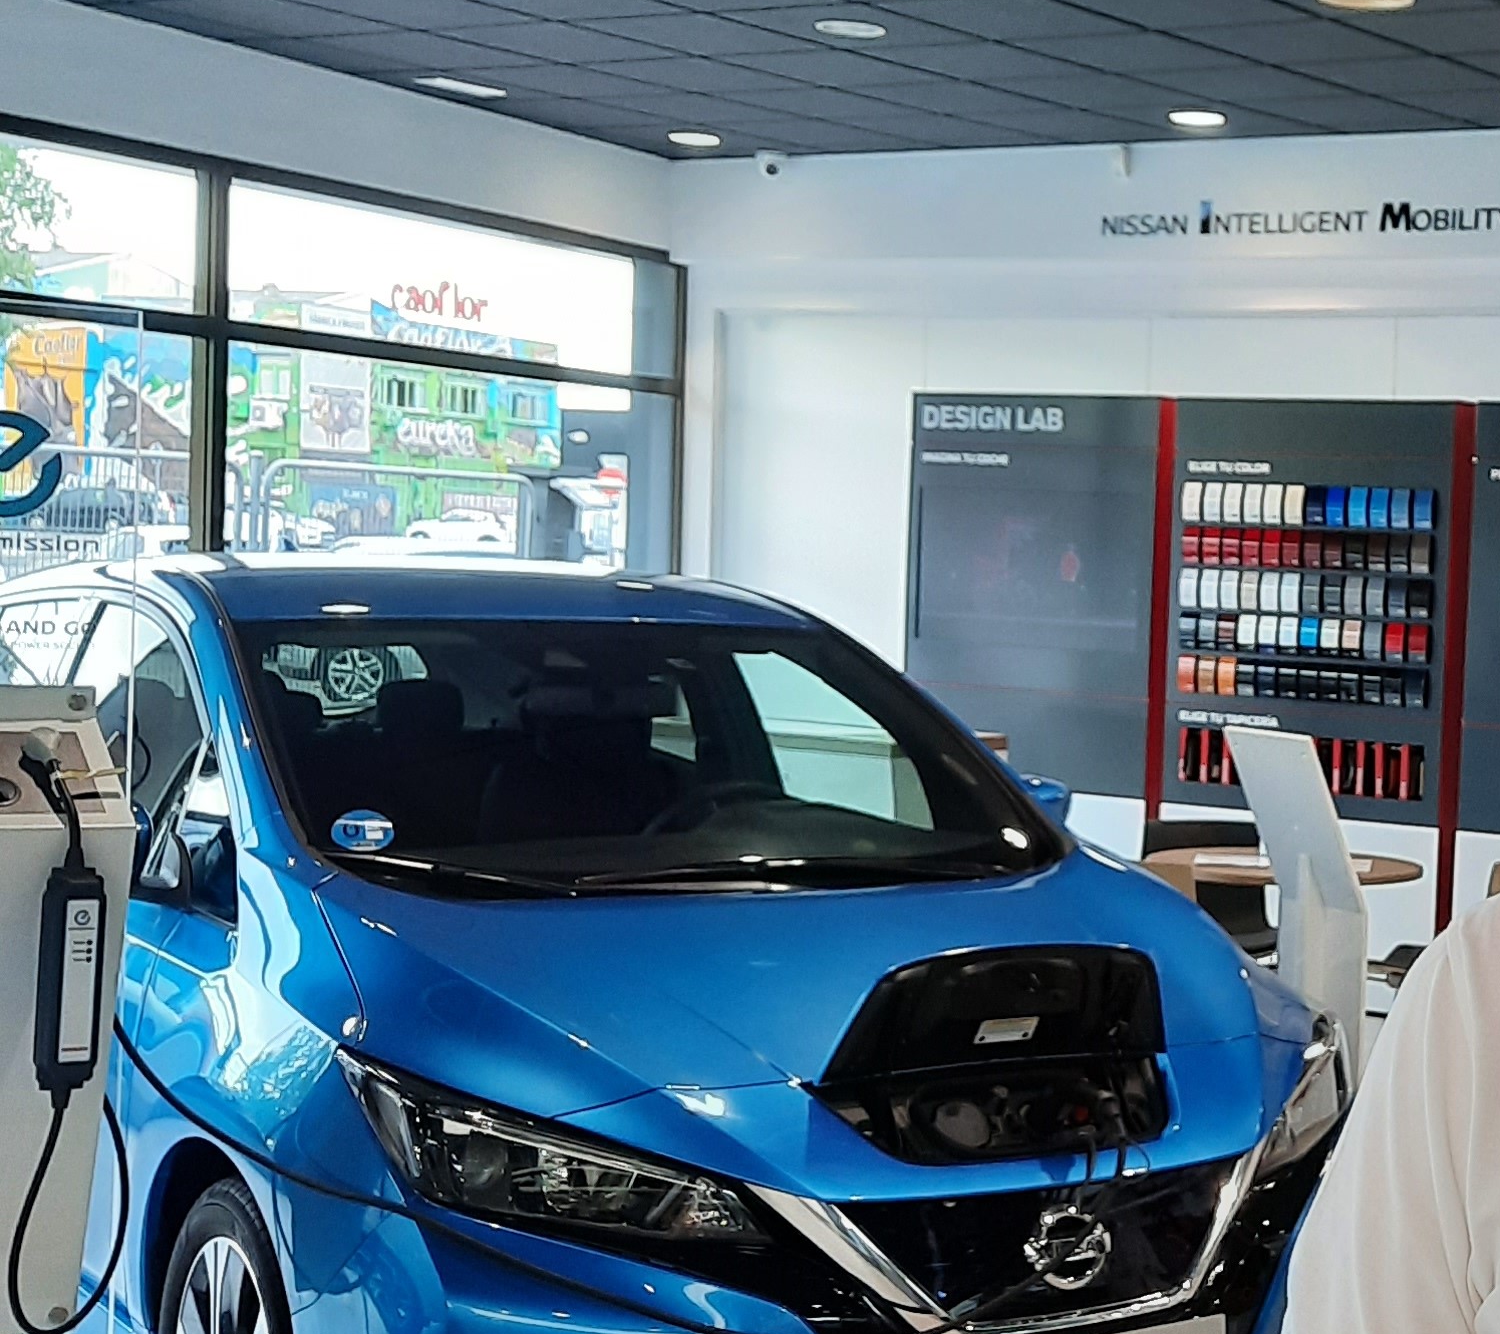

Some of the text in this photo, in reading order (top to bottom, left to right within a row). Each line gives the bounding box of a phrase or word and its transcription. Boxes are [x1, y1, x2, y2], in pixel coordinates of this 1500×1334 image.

[1101, 213, 1188, 236] NISSAN
[1200, 200, 1368, 235] INTELLIGENT
[922, 404, 1064, 433] DESIGN LAB
[5, 620, 55, 635] AND
